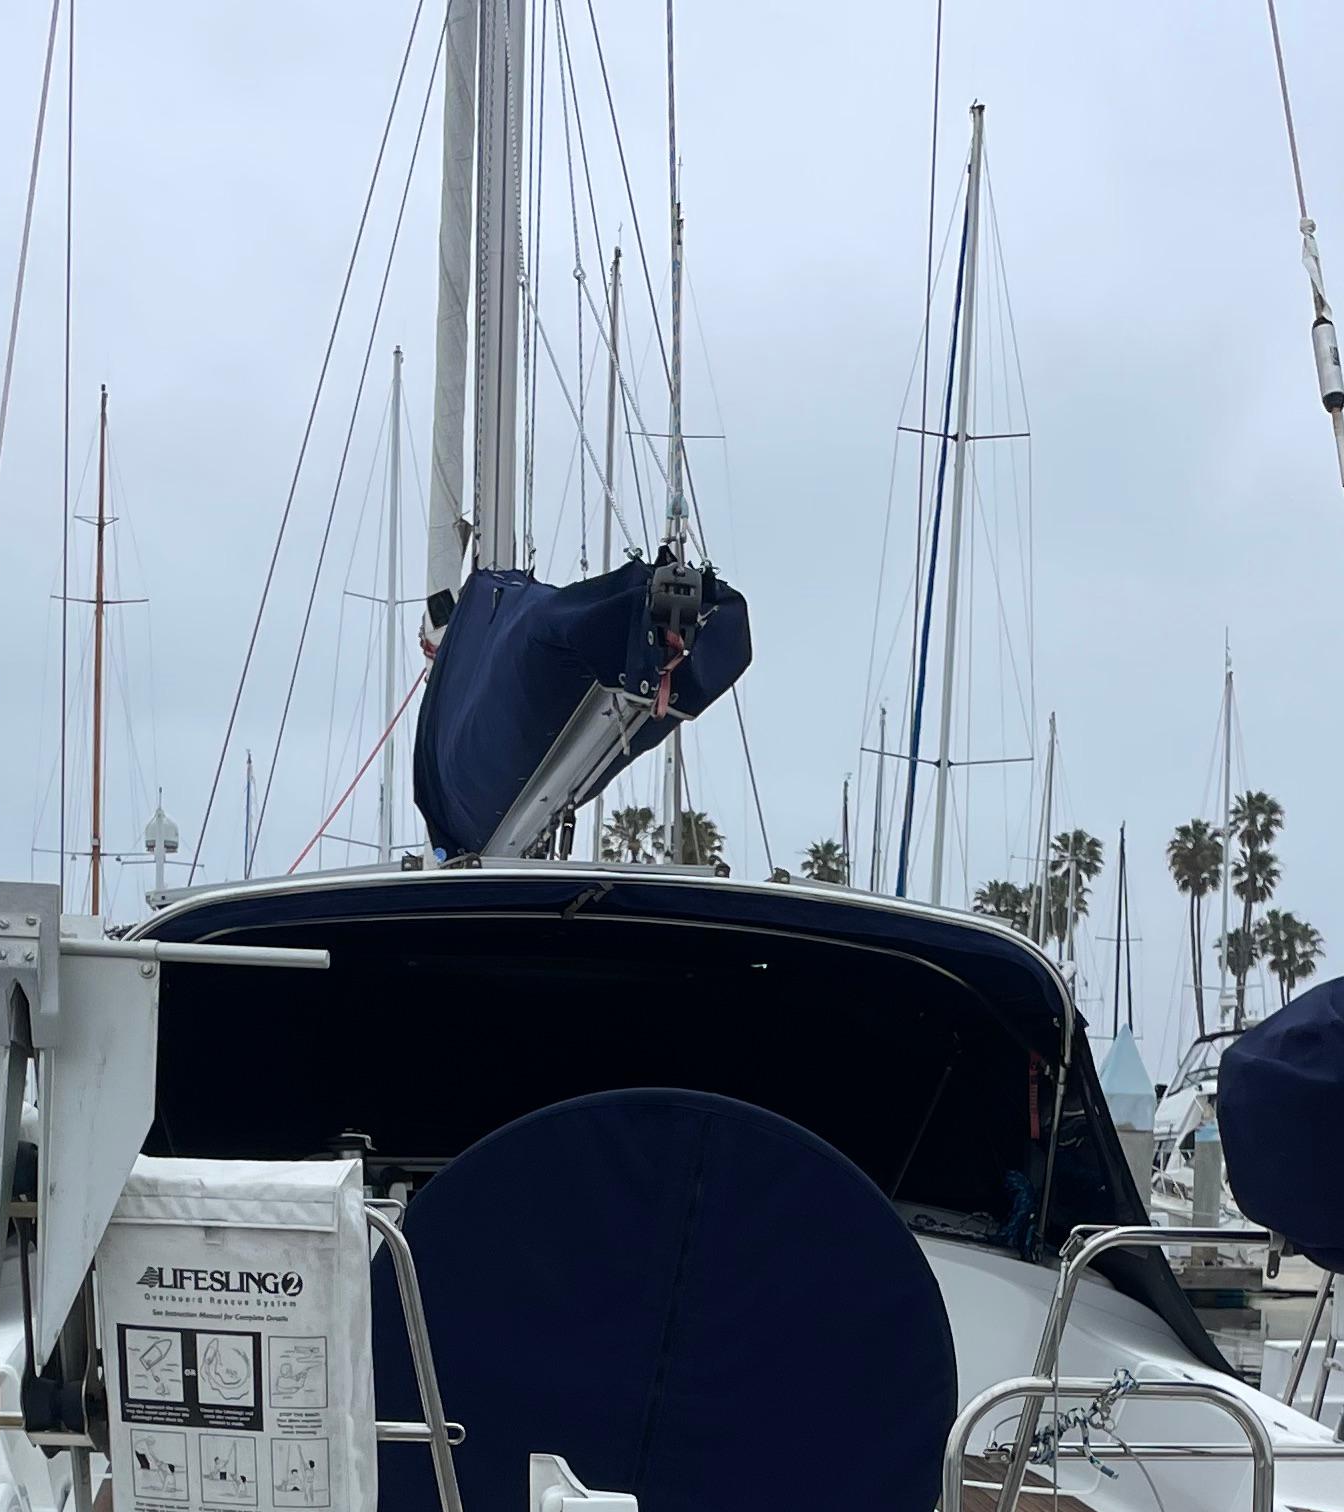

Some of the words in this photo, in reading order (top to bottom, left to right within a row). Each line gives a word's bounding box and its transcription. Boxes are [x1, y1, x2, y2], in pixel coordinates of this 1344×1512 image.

[157, 1267, 279, 1295] LIFESLING
[144, 1292, 204, 1304] Overboard
[209, 1296, 249, 1307] Rescue
[256, 1299, 297, 1308] System
